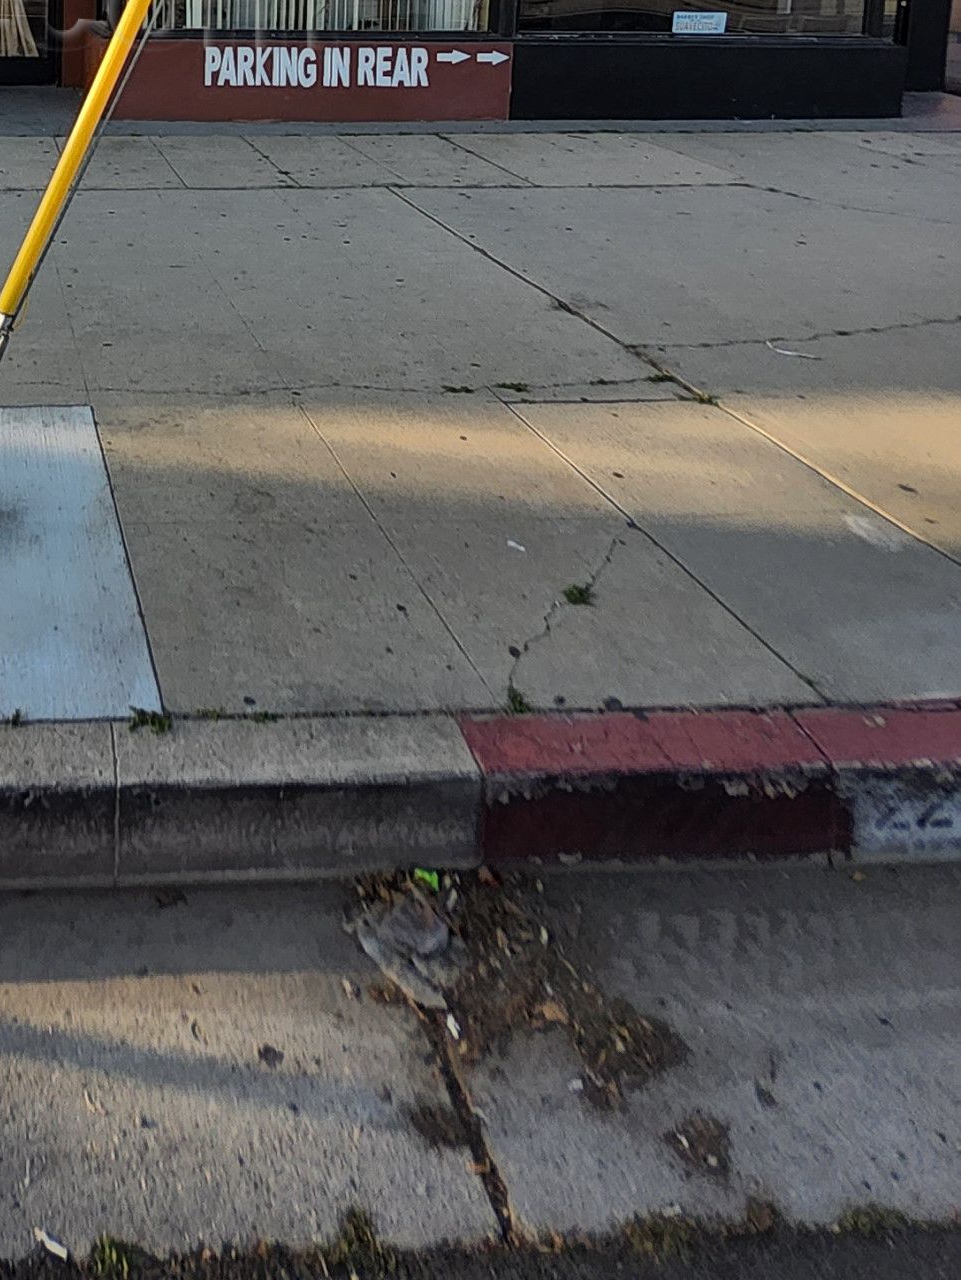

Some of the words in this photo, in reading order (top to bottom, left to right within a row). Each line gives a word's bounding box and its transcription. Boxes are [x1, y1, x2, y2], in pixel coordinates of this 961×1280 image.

[203, 46, 317, 88] PARKING
[322, 46, 351, 88] IN
[357, 46, 430, 88] REAR
